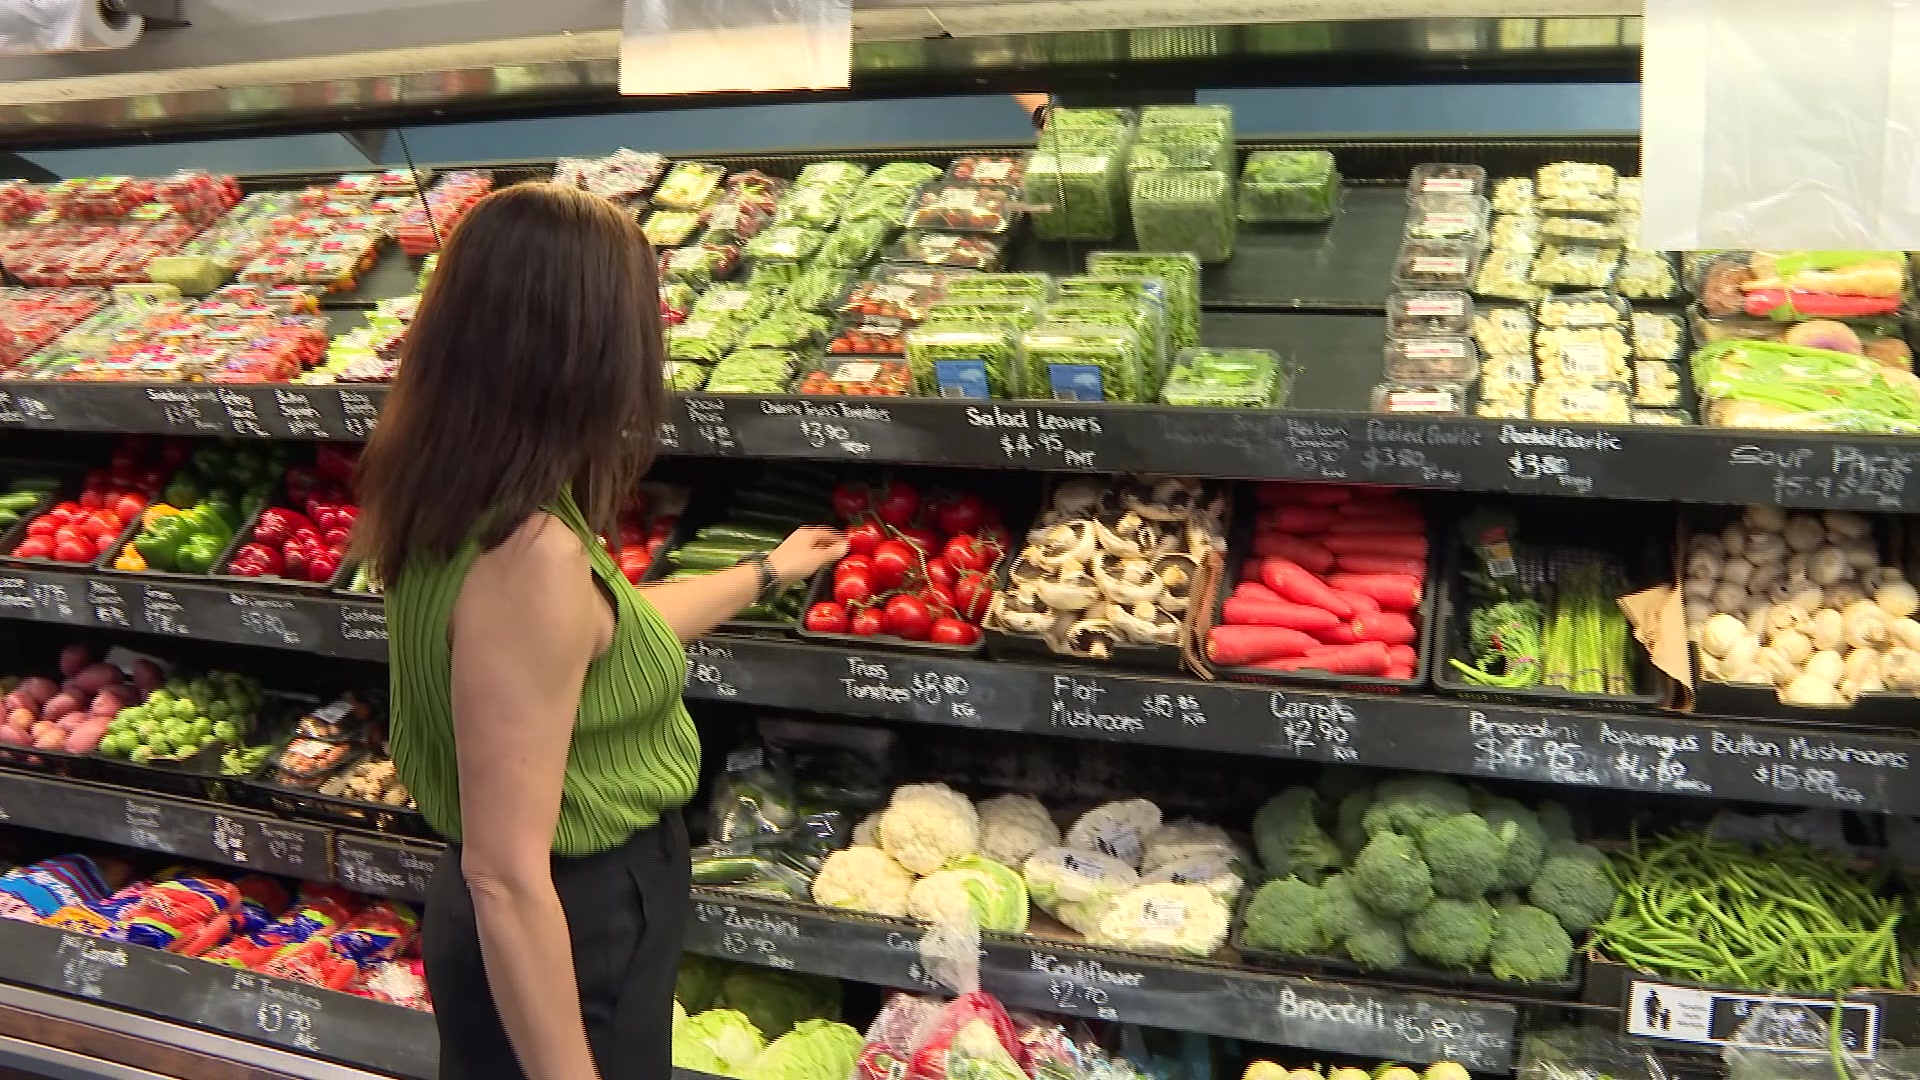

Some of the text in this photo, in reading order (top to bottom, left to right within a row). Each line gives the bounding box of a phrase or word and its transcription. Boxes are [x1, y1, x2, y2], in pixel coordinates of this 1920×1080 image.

[761, 400, 891, 422] Cherry Truss Tomatoes
[966, 404, 1102, 434] Salad Leaves
[801, 420, 848, 448] $3.90
[1000, 432, 1063, 459] $4.95
[1367, 419, 1482, 446] Peeled Garlic
[1500, 424, 1623, 452] Peeled Garlic
[1065, 451, 1096, 467] PNT
[1508, 449, 1569, 479] $3.80
[241, 610, 286, 635] $8.80
[683, 640, 733, 660] cchini
[685, 659, 721, 688] 7.80
[847, 656, 888, 681] Truss
[717, 682, 738, 697] KG
[840, 671, 970, 705] Tomatoes $8.80
[1054, 675, 1106, 705] Flat
[951, 702, 976, 719] KG
[1051, 698, 1145, 734] Mushrooms
[1182, 711, 1207, 728] KG
[1270, 691, 1356, 722] Carrots
[1284, 719, 1349, 752] $2.90
[1470, 710, 1909, 769] Broccolini Asparagus Button Mushrooms
[1474, 735, 1582, 772] $4.95
[338, 840, 434, 879] Ginger Galang
[724, 905, 801, 938] Zucchini
[81, 939, 129, 967] Carrots
[723, 932, 776, 955] $3.90
[1044, 955, 1146, 987] Cauliflower
[260, 977, 322, 1010] Tomatoes
[1048, 979, 1108, 1009] $2.70
[1279, 986, 1385, 1029] Broccoli
[1394, 1013, 1464, 1044] $5.80
